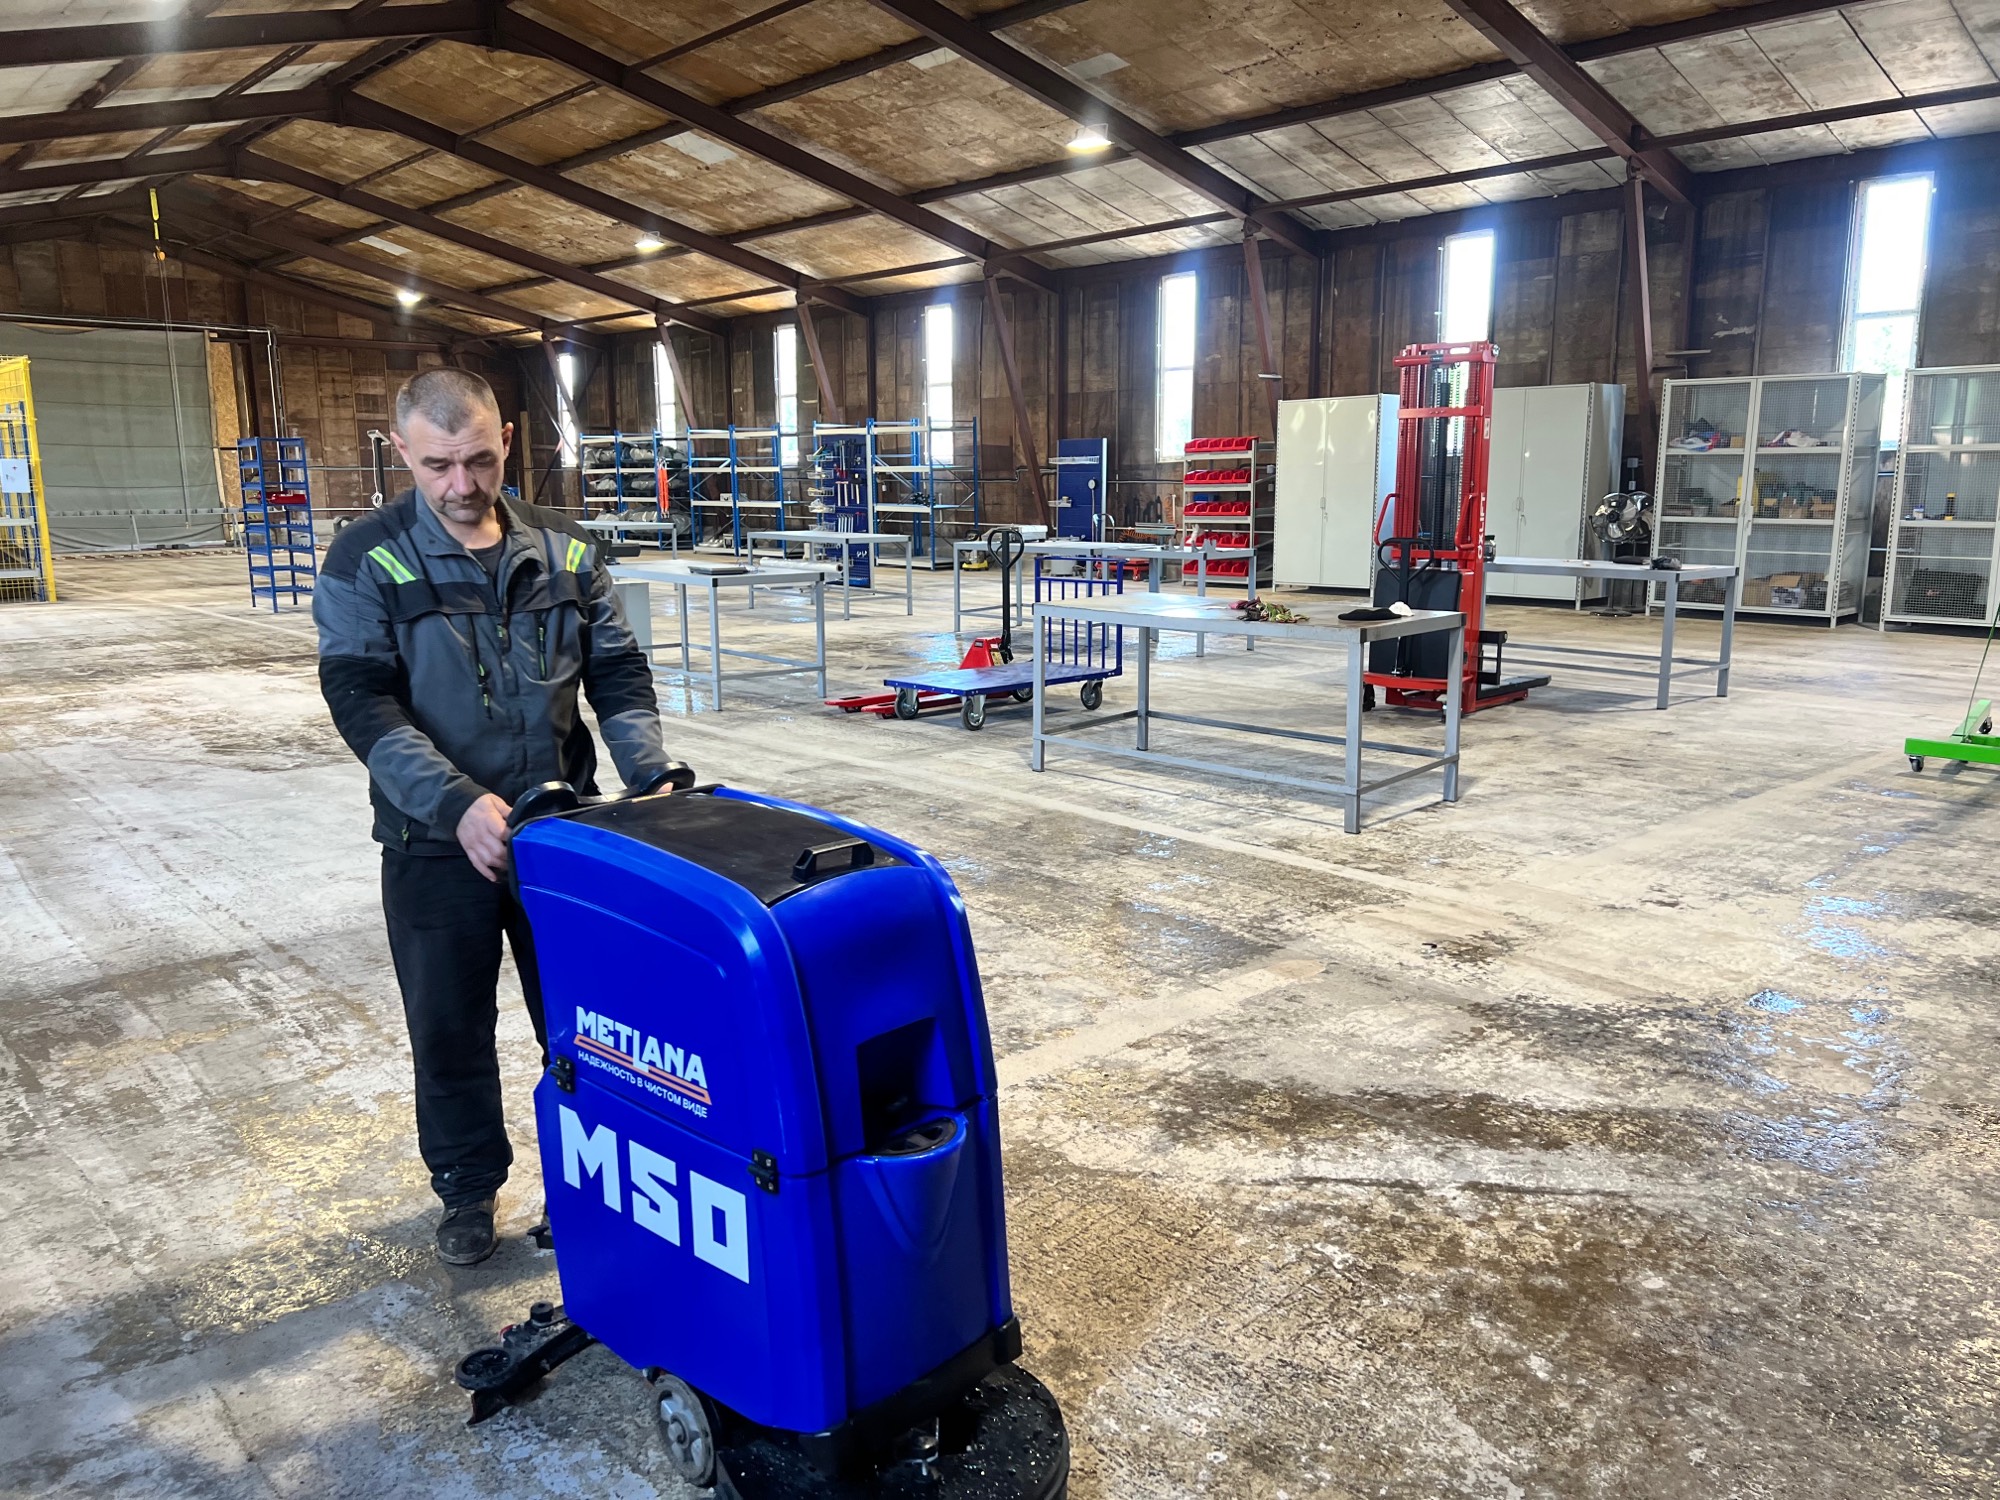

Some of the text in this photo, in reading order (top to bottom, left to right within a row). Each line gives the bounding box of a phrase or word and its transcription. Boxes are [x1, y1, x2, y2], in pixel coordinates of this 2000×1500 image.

[576, 1006, 708, 1089] METLANA
[578, 1050, 636, 1084] НАДЕЖНОСТЬ
[644, 1080, 681, 1106] ЧИСТОМ
[682, 1098, 708, 1118] ВИДЕ
